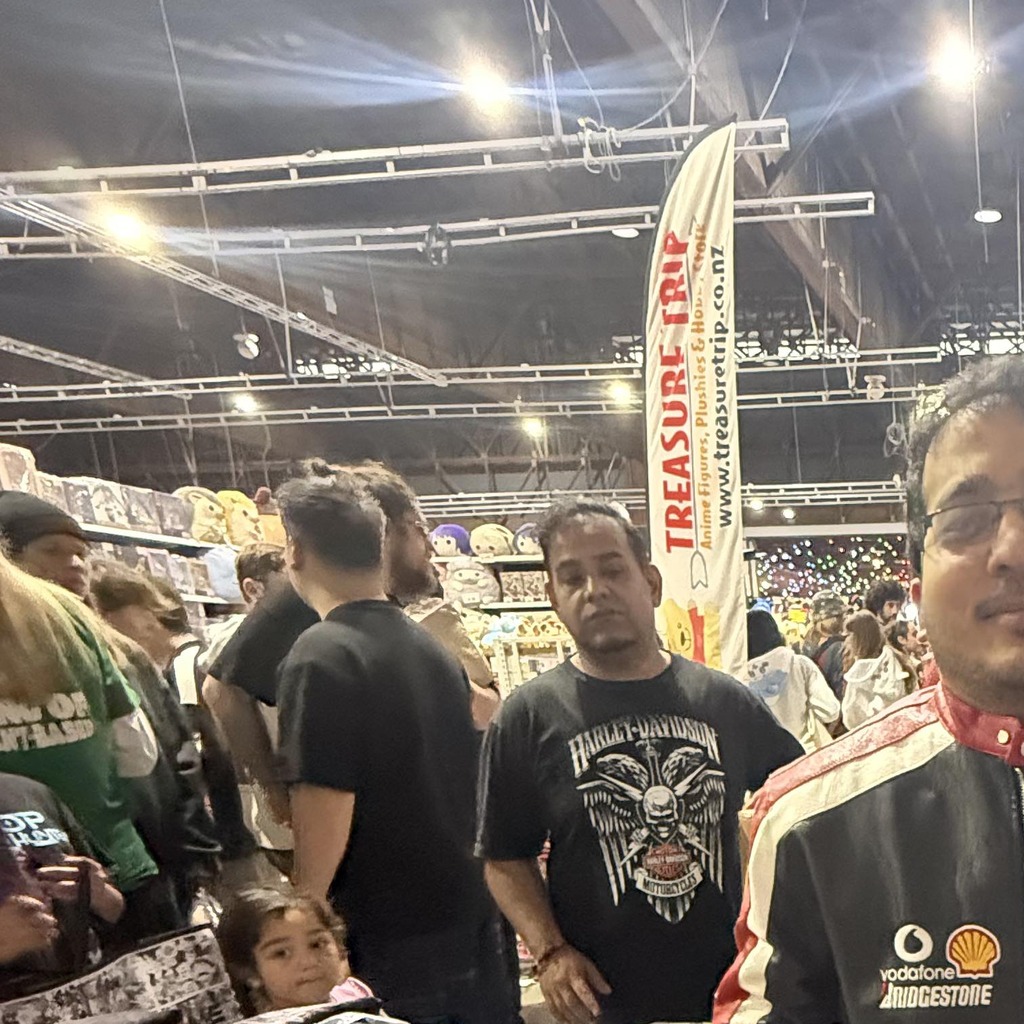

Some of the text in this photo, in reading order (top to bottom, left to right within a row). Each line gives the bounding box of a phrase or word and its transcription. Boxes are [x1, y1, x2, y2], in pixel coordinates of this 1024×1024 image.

[691, 338, 705, 352] &
[659, 231, 694, 553] TREASURE TRIP
[694, 355, 709, 428] Plushies
[709, 246, 732, 528] www.treasuretrip.co.nz
[697, 432, 712, 496] Figures,
[700, 500, 713, 550] Anime
[879, 981, 993, 1009] BRIDGESTONE
[880, 964, 956, 981] vodafone
